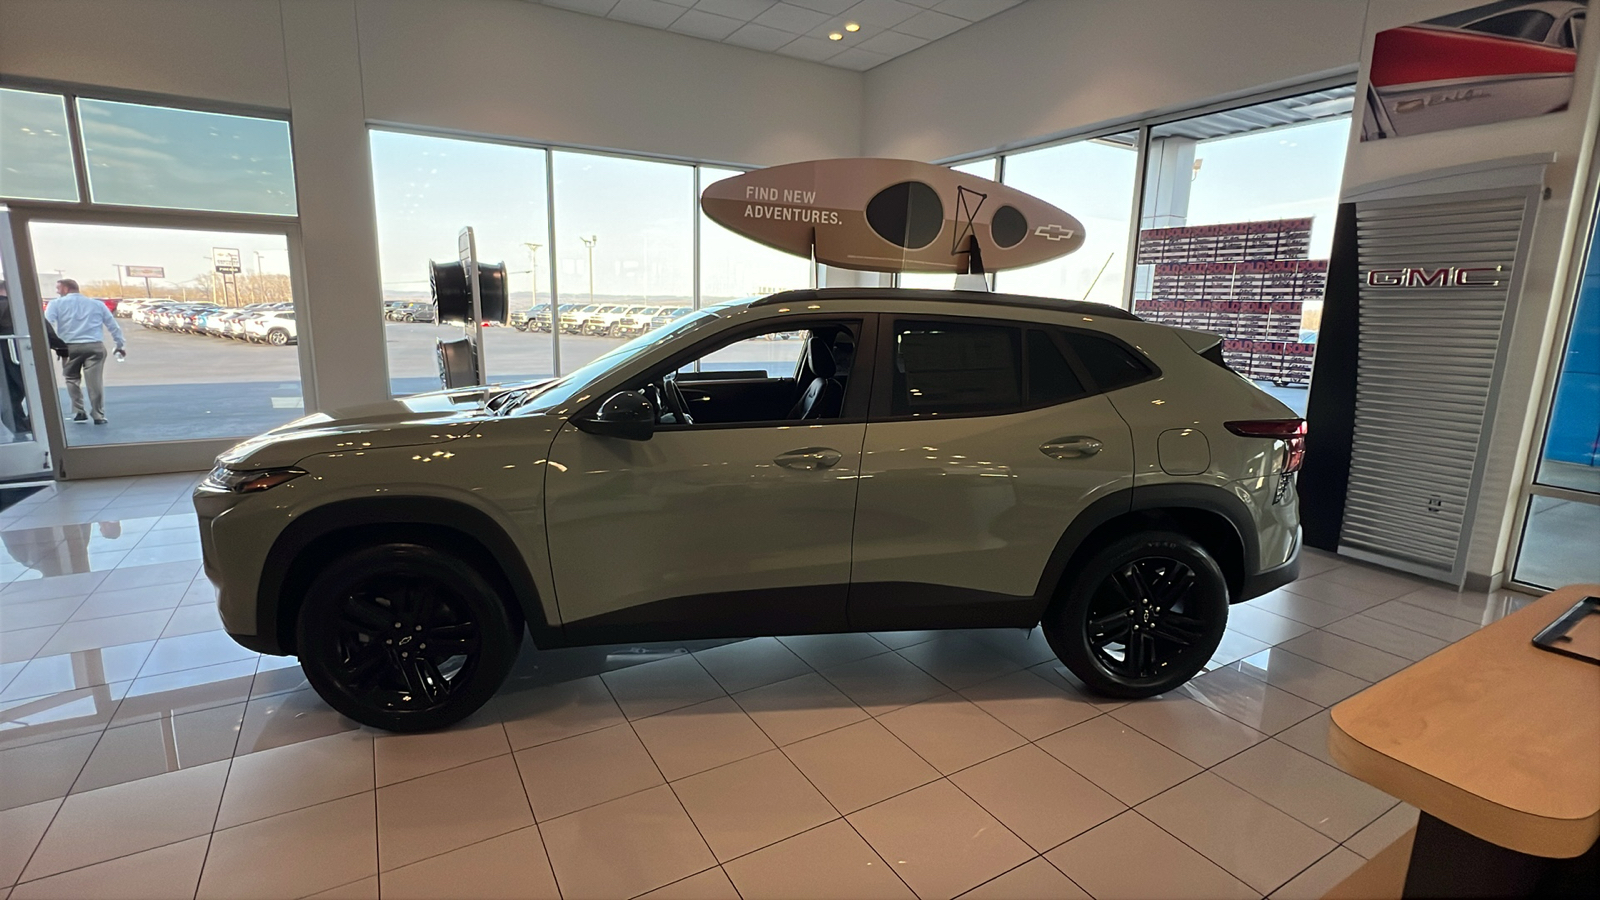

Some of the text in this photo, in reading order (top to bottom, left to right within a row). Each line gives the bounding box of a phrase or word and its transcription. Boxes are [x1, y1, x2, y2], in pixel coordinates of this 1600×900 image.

[746, 186, 816, 204] FIND NEW
[744, 204, 842, 225] ADVENTURES.
[1156, 265, 1180, 274] SOLD
[1180, 264, 1207, 274] SOLD
[1207, 263, 1235, 274] SOLD
[1237, 262, 1265, 272] SOLD
[1266, 261, 1297, 272] SOLD
[1299, 260, 1328, 271] SOL
[1368, 266, 1501, 287] GMC
[1225, 341, 1252, 351] SOLD
[1254, 342, 1282, 353] SOLD
